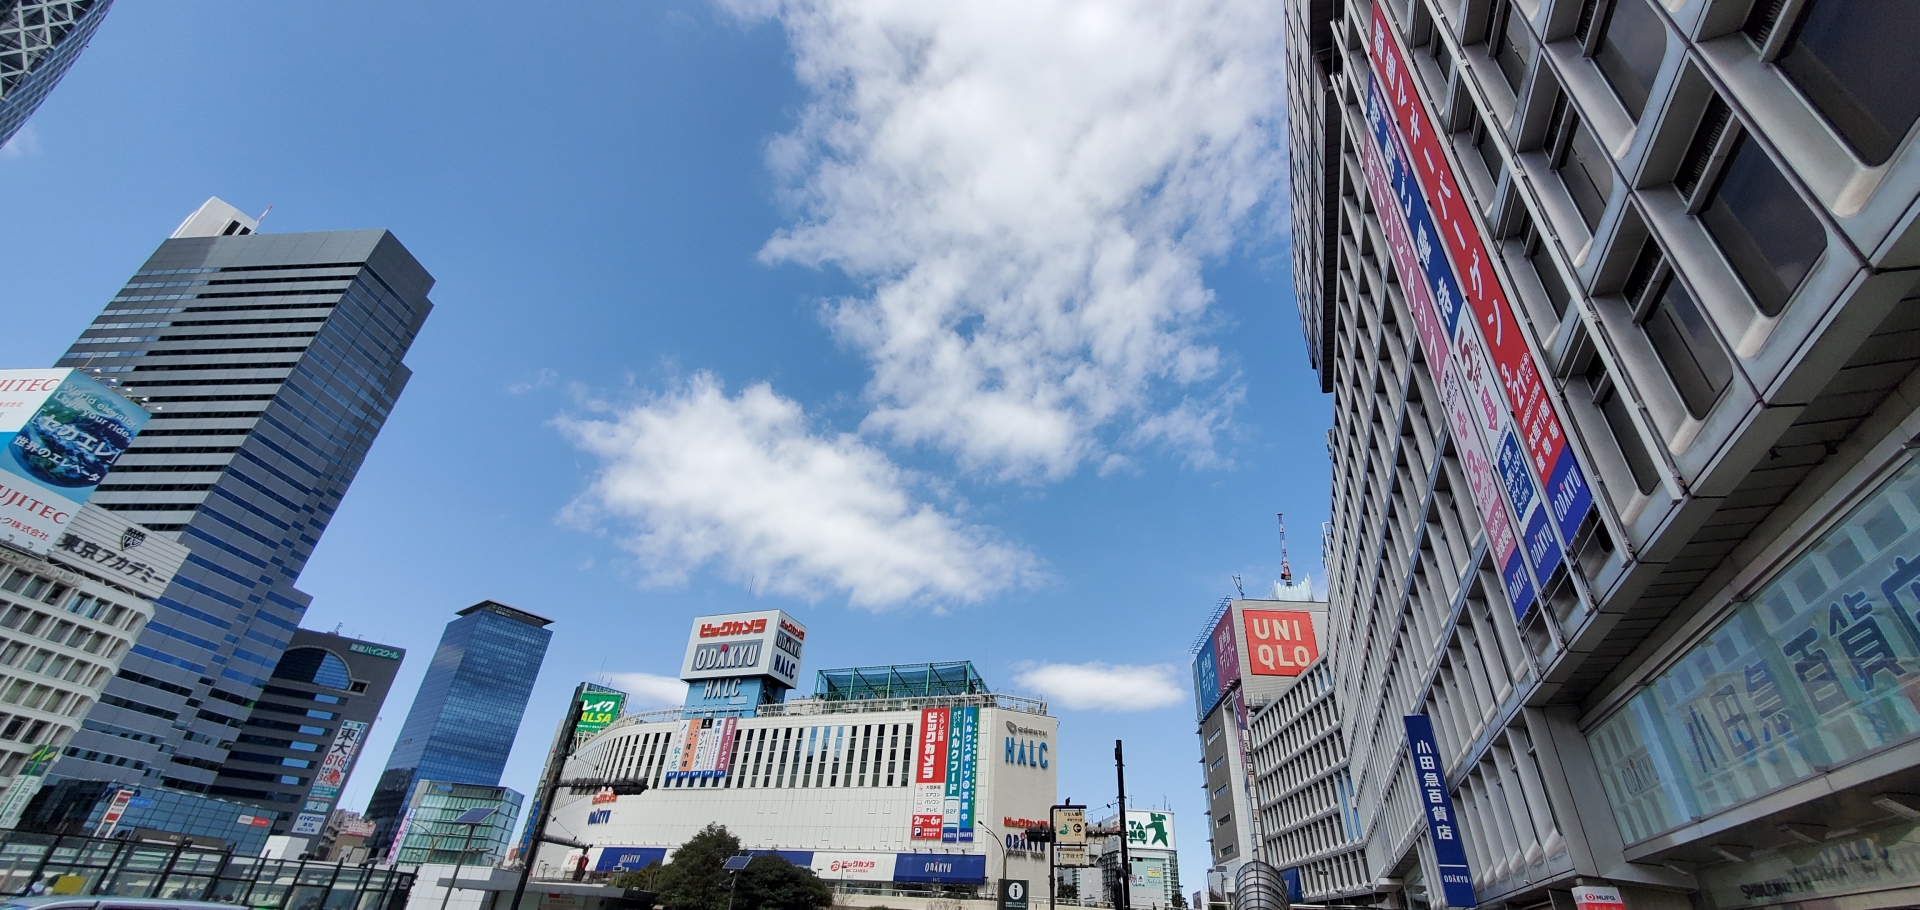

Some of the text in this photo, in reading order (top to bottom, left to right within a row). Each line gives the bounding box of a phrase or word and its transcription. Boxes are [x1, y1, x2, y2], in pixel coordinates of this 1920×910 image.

[1376, 18, 1502, 348] 銀座マギーバーゲン
[1369, 144, 1440, 372] ポイントアップ
[82, 408, 108, 427] your
[14, 435, 101, 482] 世界のエレベータ
[1554, 465, 1581, 522] ODAKYU
[55, 532, 166, 583] 東京アカデミー
[1530, 523, 1553, 569] ODAKYU
[1509, 563, 1528, 604] ODAKYU
[700, 618, 767, 638] ビックカメラ
[780, 618, 805, 641] ビックカメラ
[1253, 618, 1302, 641] UNI
[695, 644, 758, 670] ODAKYU
[777, 632, 801, 659] ODAKYU
[1257, 645, 1310, 670] QLO
[774, 654, 796, 680] HALC
[703, 678, 741, 699] HALC
[581, 712, 612, 723] ALSA
[582, 700, 615, 712] レイク
[331, 727, 359, 755] 東大
[922, 711, 938, 779] ビックカメラ
[1005, 736, 1048, 768] HALC
[325, 754, 347, 767] 816
[949, 727, 960, 794] ハルクフード
[1417, 740, 1453, 840] 小田急百貨店
[914, 827, 921, 836] P
[1129, 821, 1144, 830] TA
[1129, 830, 1146, 839] NO
[620, 853, 640, 863] ODAKYU
[925, 861, 952, 873] ODAKYU
[1444, 874, 1468, 884] ODAKYU
